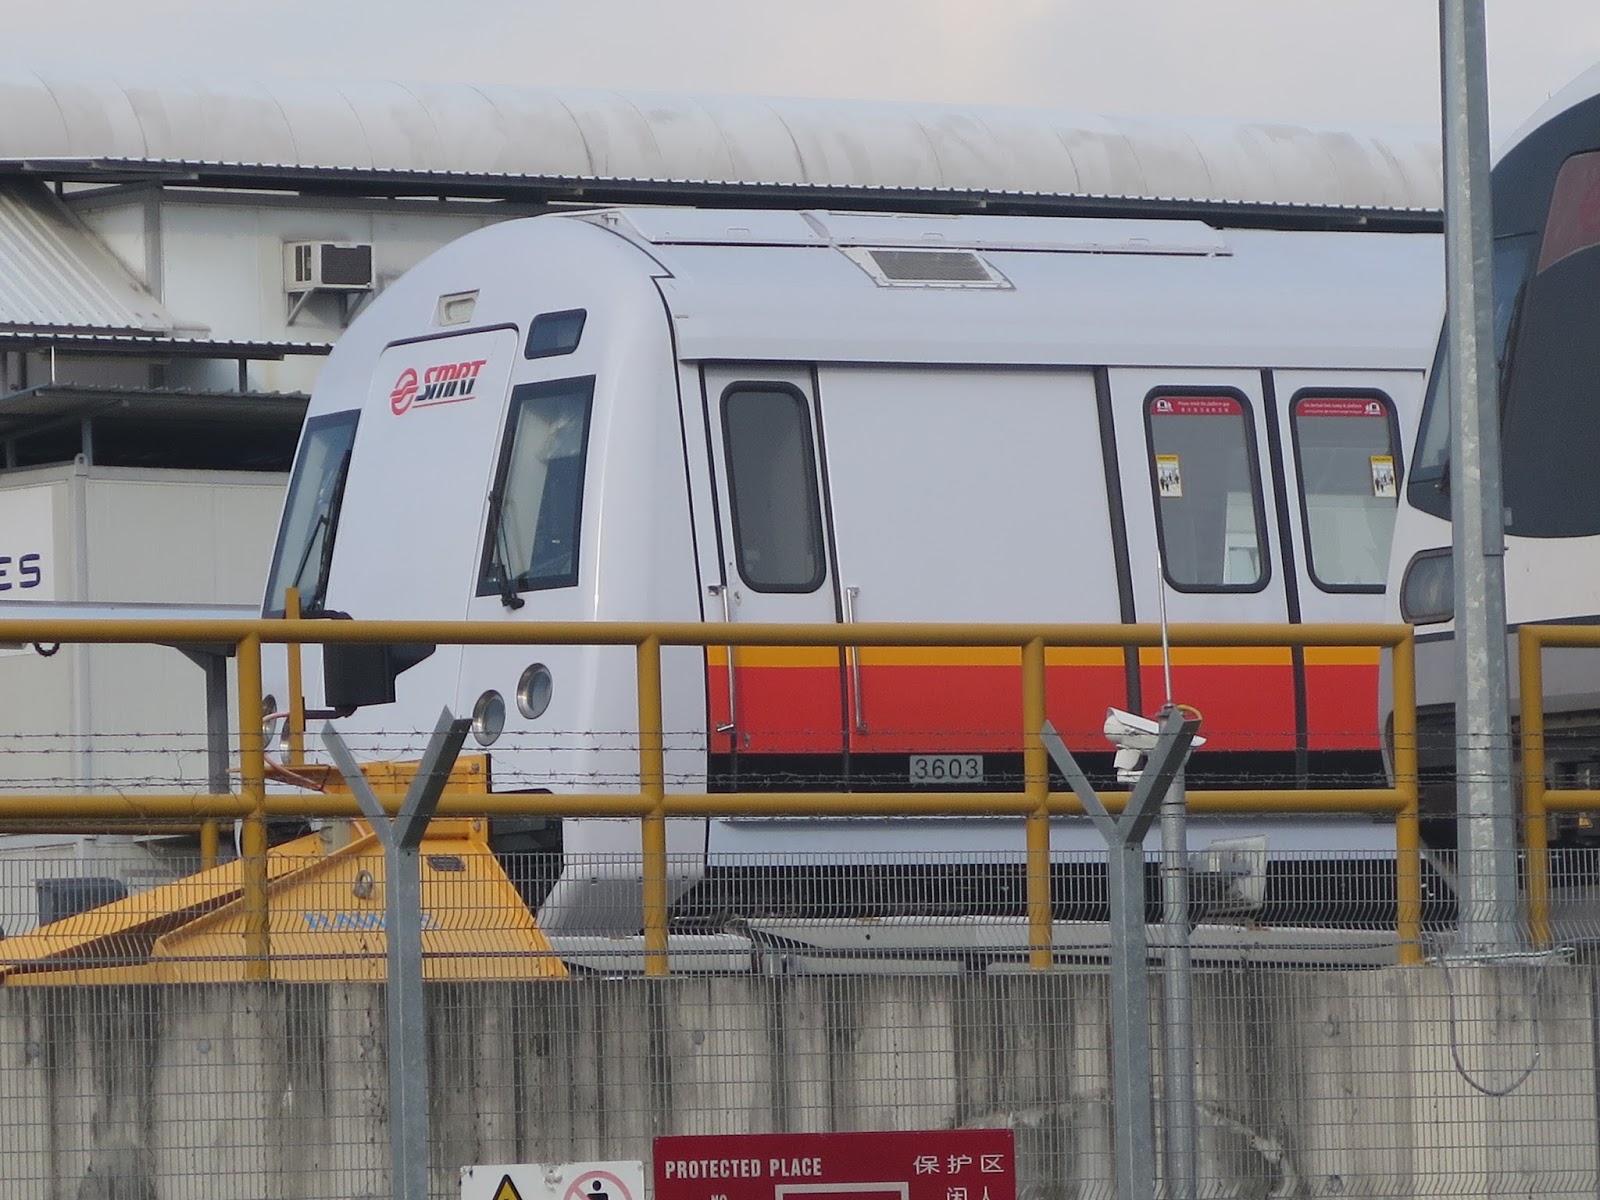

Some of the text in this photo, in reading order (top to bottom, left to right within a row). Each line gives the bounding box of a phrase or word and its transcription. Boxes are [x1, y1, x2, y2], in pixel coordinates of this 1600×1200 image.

[414, 359, 488, 402] SMRT
[914, 758, 978, 780] 3603
[664, 1157, 822, 1179] PROTECTED PLACE
[912, 1154, 1005, 1175] 保护区
